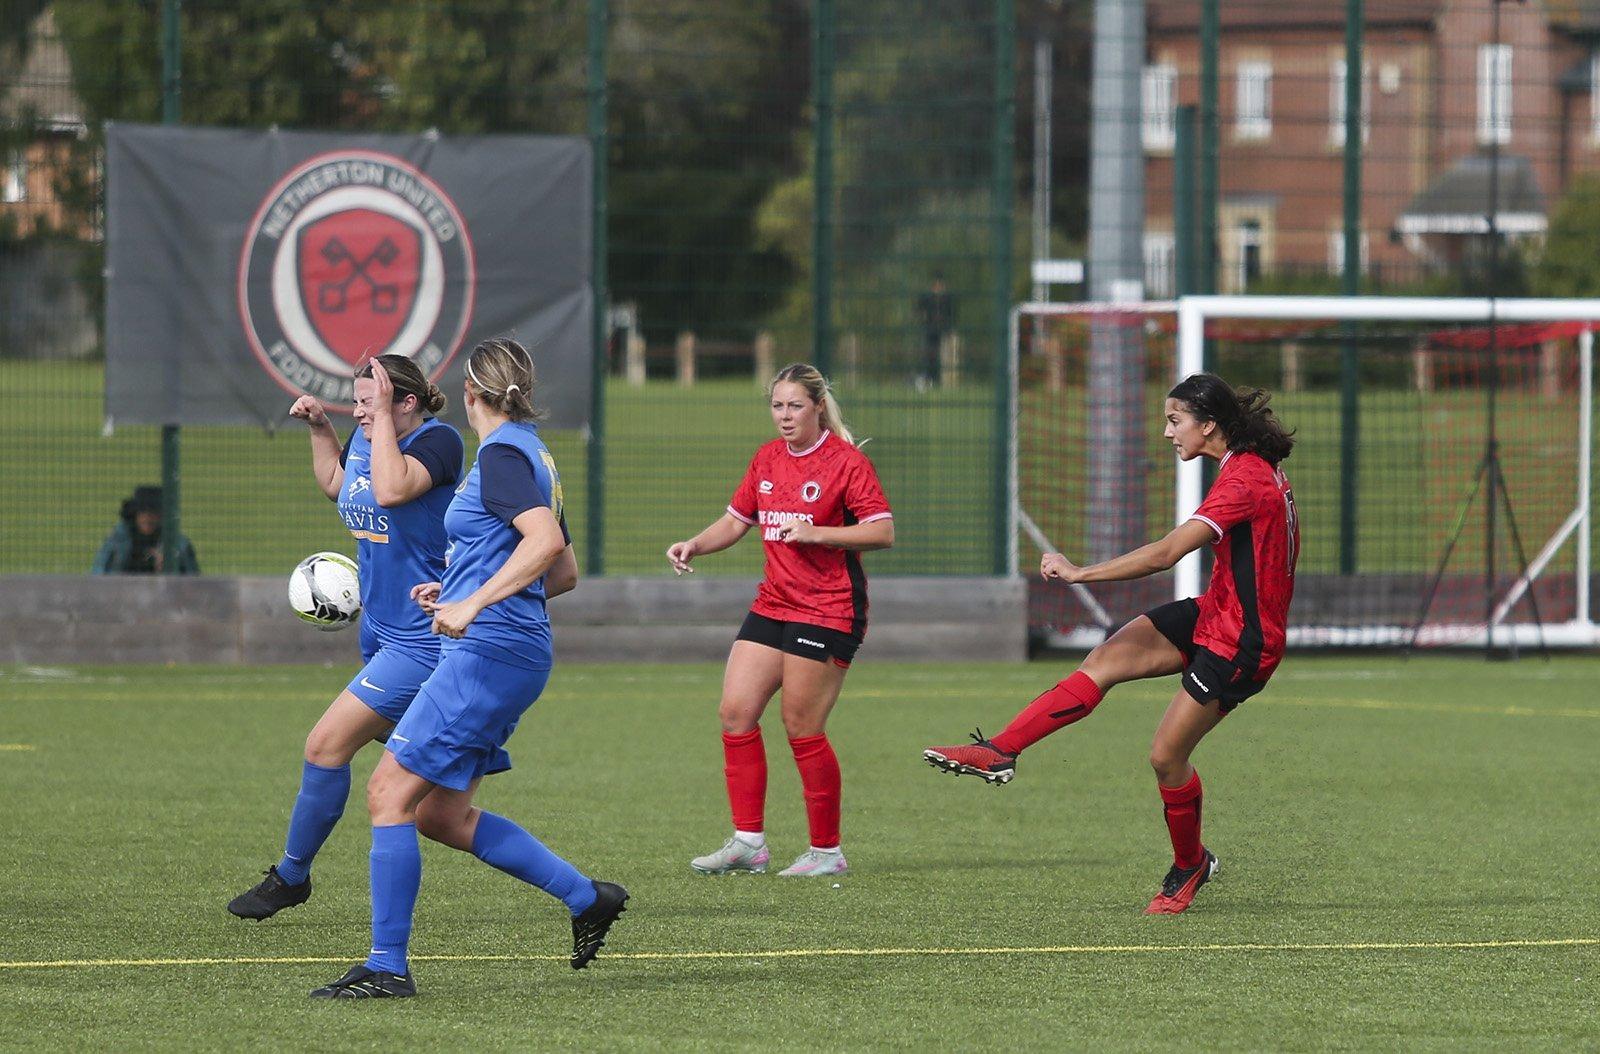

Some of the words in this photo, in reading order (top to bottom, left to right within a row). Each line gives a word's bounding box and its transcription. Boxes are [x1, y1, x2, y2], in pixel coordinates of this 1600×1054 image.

[262, 161, 385, 240] NETHERTON
[387, 168, 456, 243] UNITED
[269, 340, 355, 401] FOOTBA
